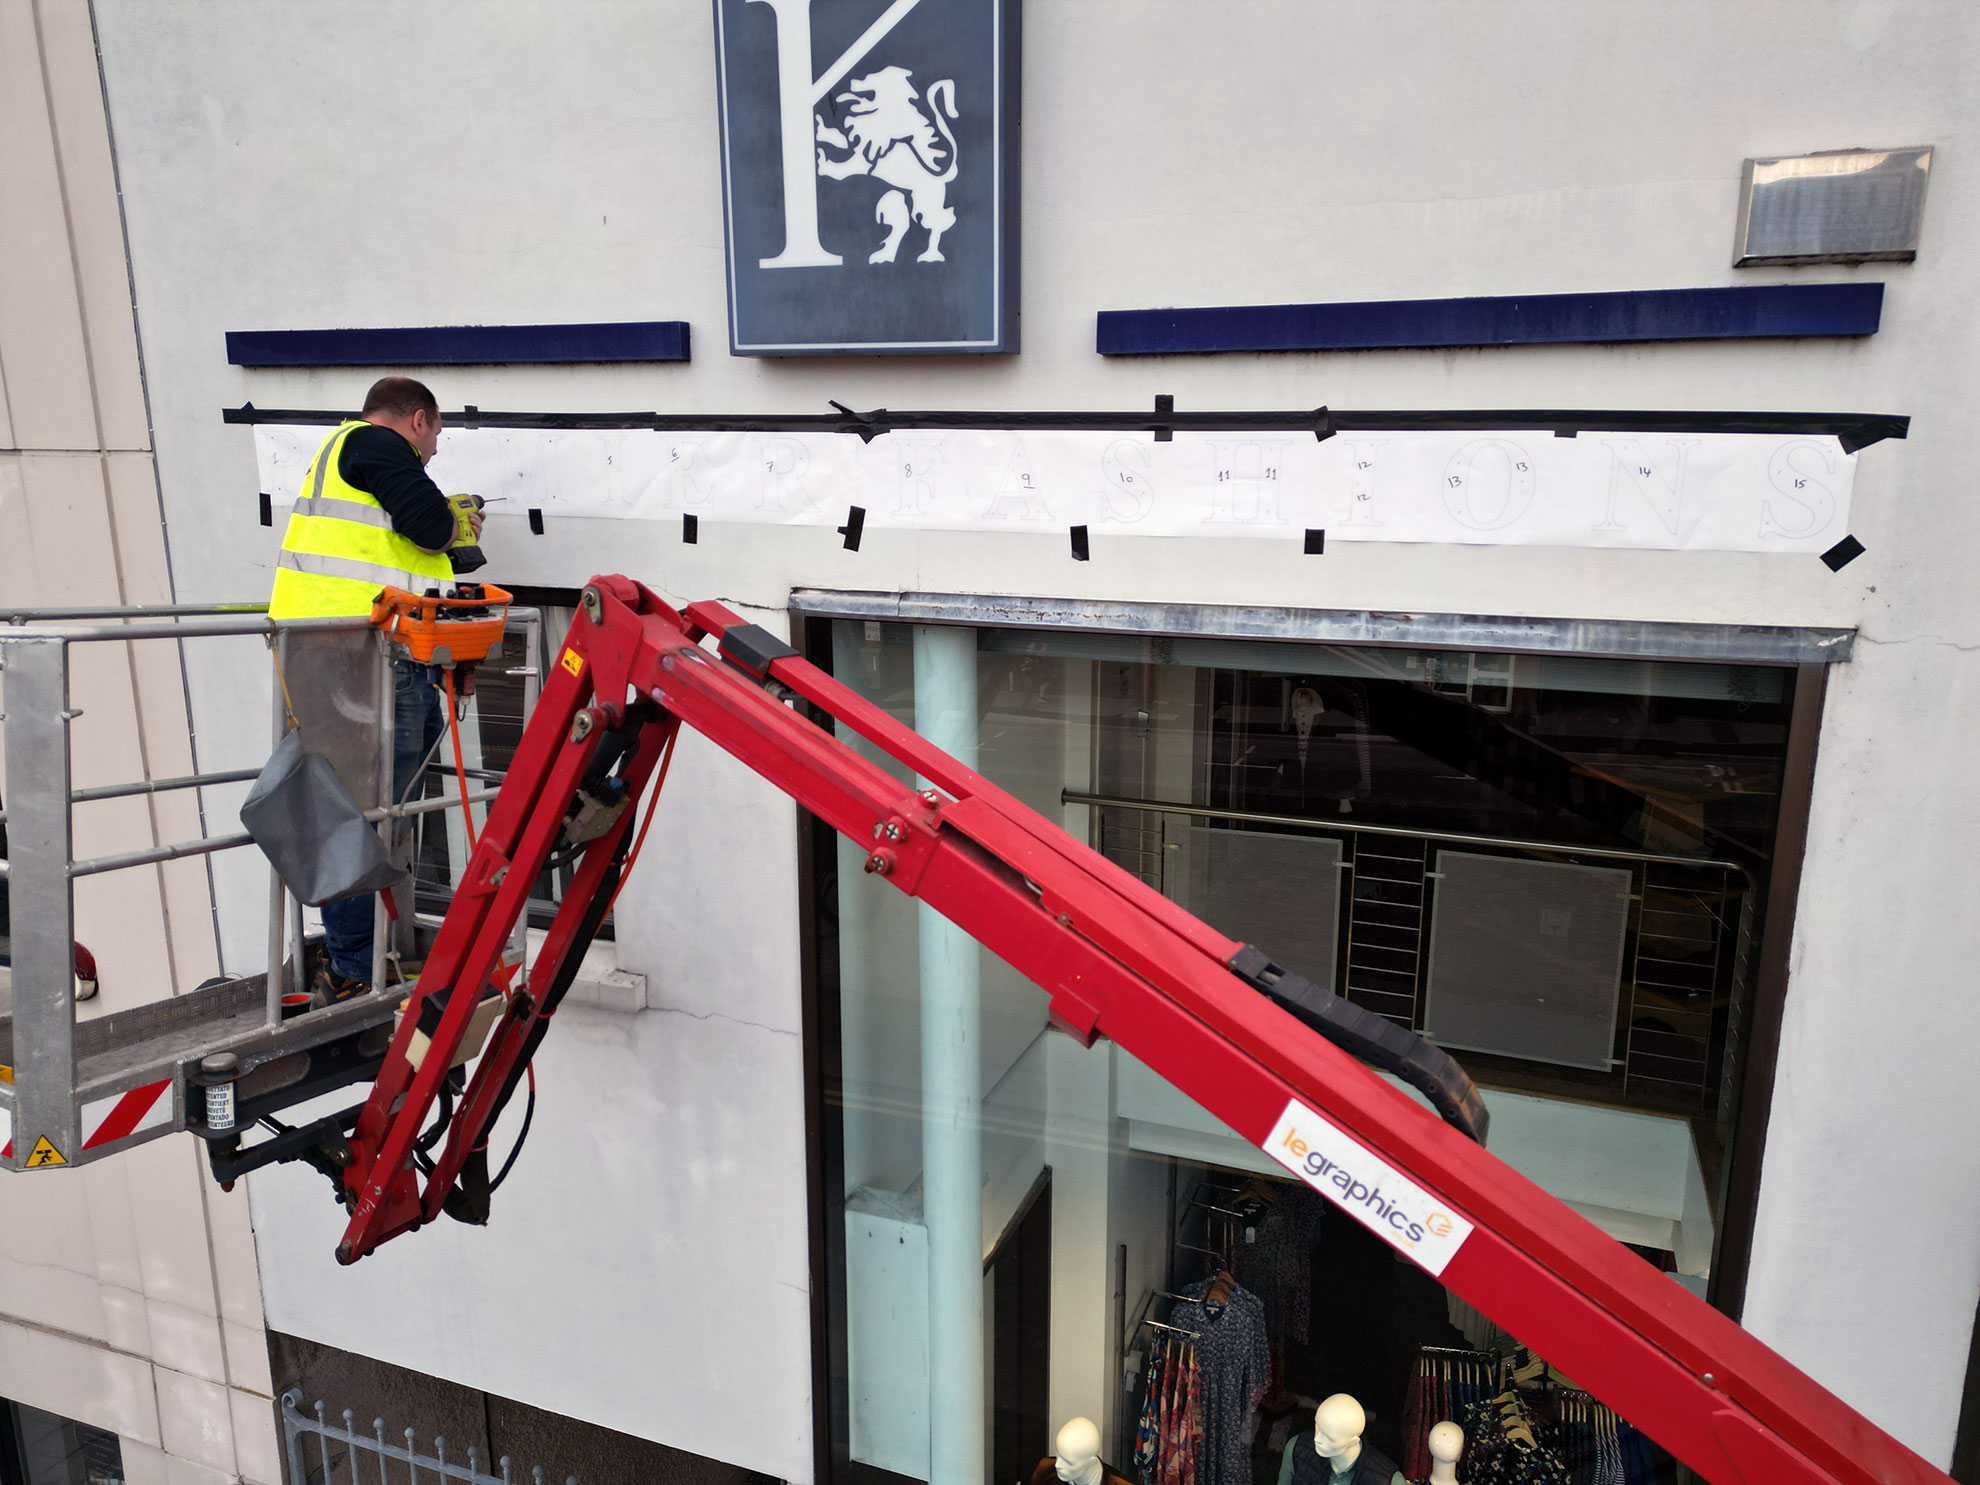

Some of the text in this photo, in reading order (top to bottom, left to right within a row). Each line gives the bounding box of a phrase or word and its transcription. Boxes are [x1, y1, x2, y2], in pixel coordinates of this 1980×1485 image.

[904, 463, 913, 478] 8
[1515, 461, 1529, 473] 13
[1638, 466, 1652, 478] 14
[1021, 473, 1032, 486] 9
[1447, 475, 1463, 488] 13
[1793, 478, 1807, 489] 15
[1282, 1128, 1425, 1243] legraphics
